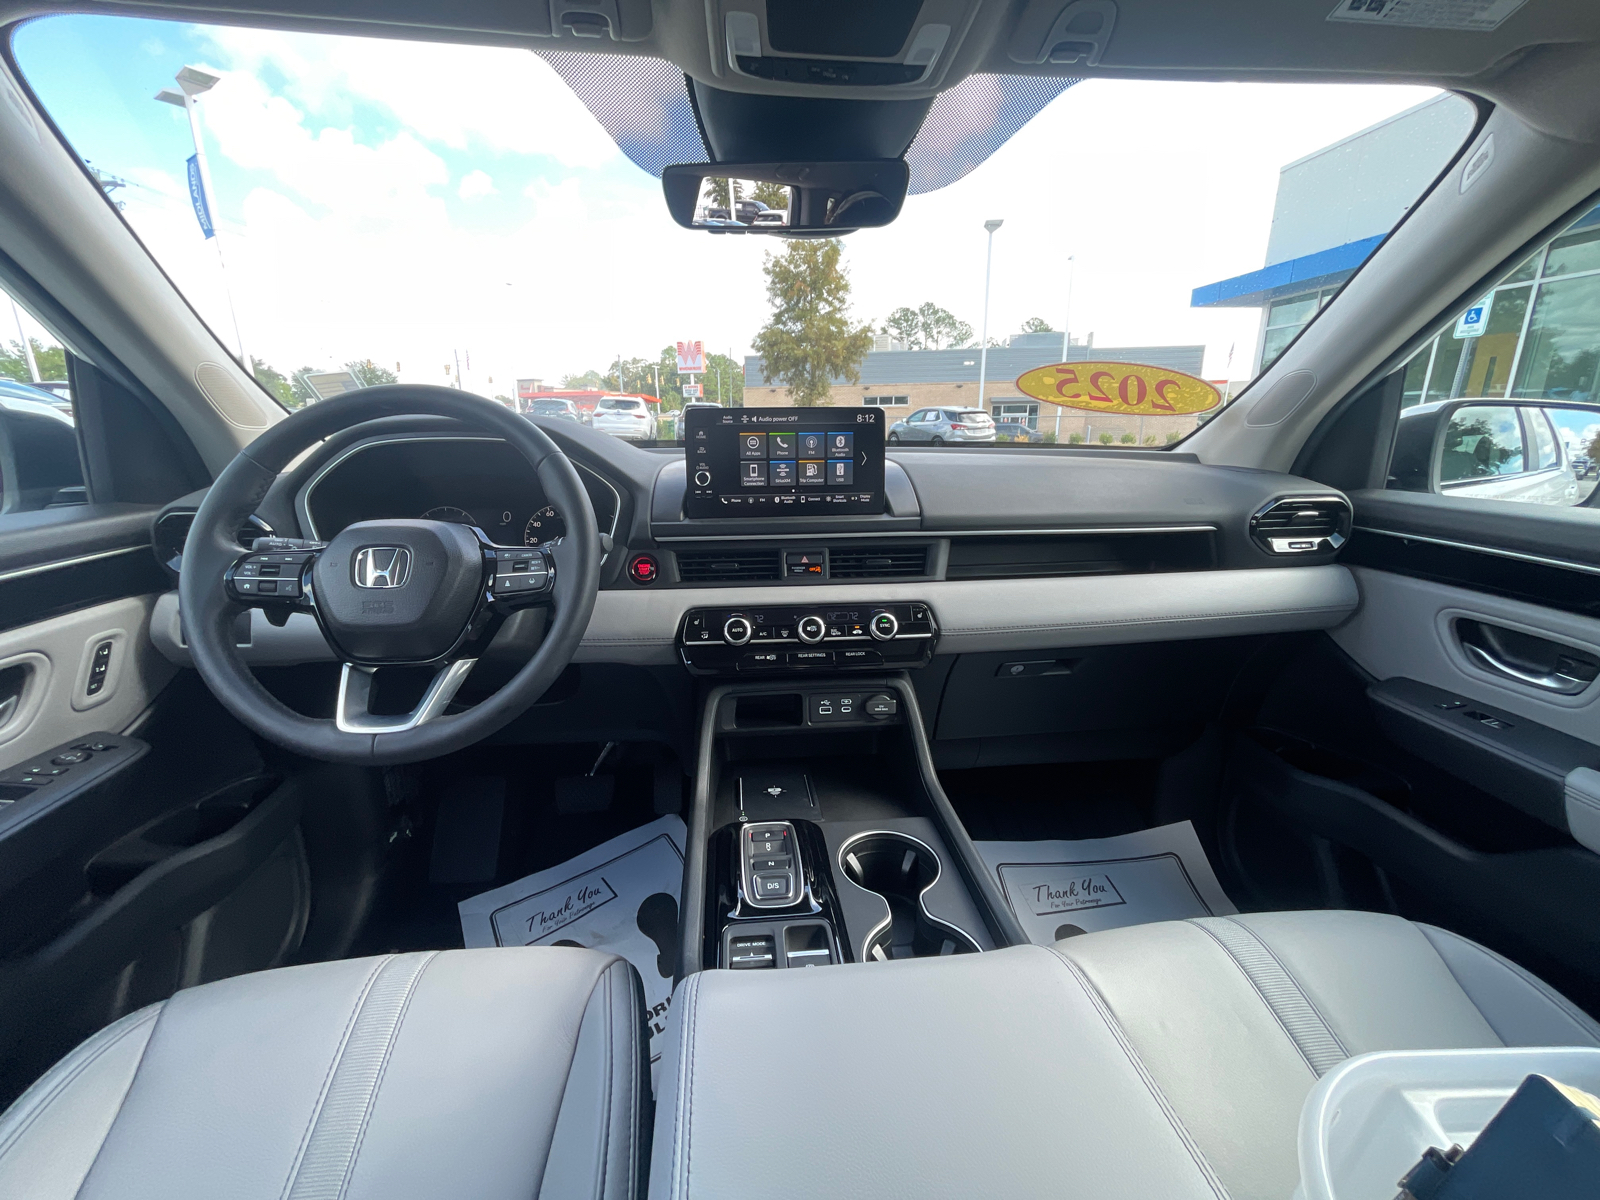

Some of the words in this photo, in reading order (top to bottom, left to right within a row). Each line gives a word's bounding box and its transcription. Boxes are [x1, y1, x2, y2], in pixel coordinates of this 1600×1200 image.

[190, 163, 208, 230] MIDLANDS
[856, 414, 875, 423] 8:12
[502, 511, 512, 522] 0
[1032, 882, 1079, 902] Thank
[1082, 878, 1107, 896] You
[526, 896, 574, 932] Thank
[578, 886, 602, 903] You
